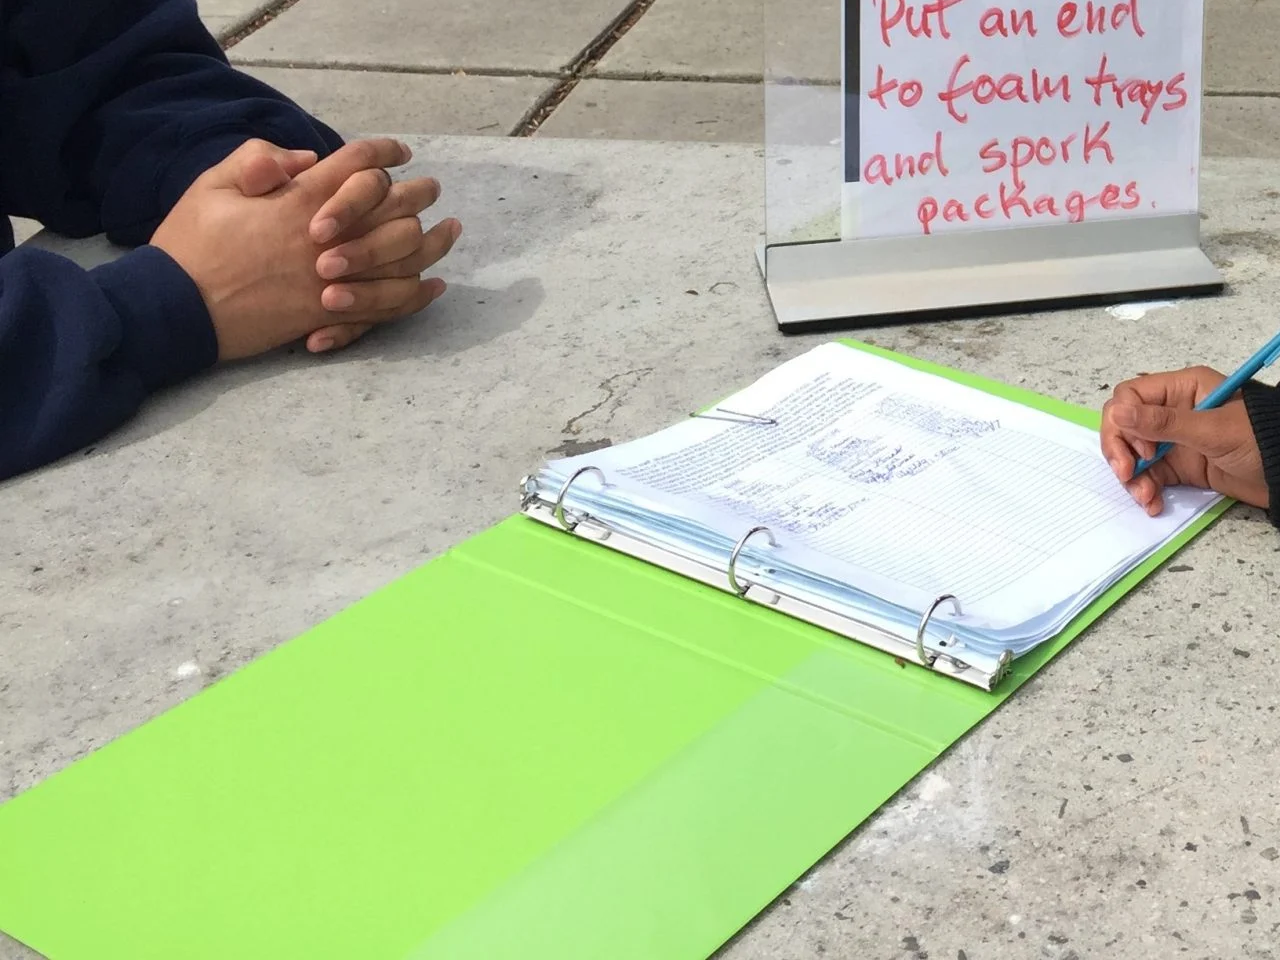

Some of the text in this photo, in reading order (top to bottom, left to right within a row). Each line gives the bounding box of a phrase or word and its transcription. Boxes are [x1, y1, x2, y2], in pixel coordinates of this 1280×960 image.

[979, 7, 1037, 38] an
[868, 53, 1188, 124] to foam trays
[864, 120, 1115, 190] and spork
[917, 181, 1156, 235] packages.
